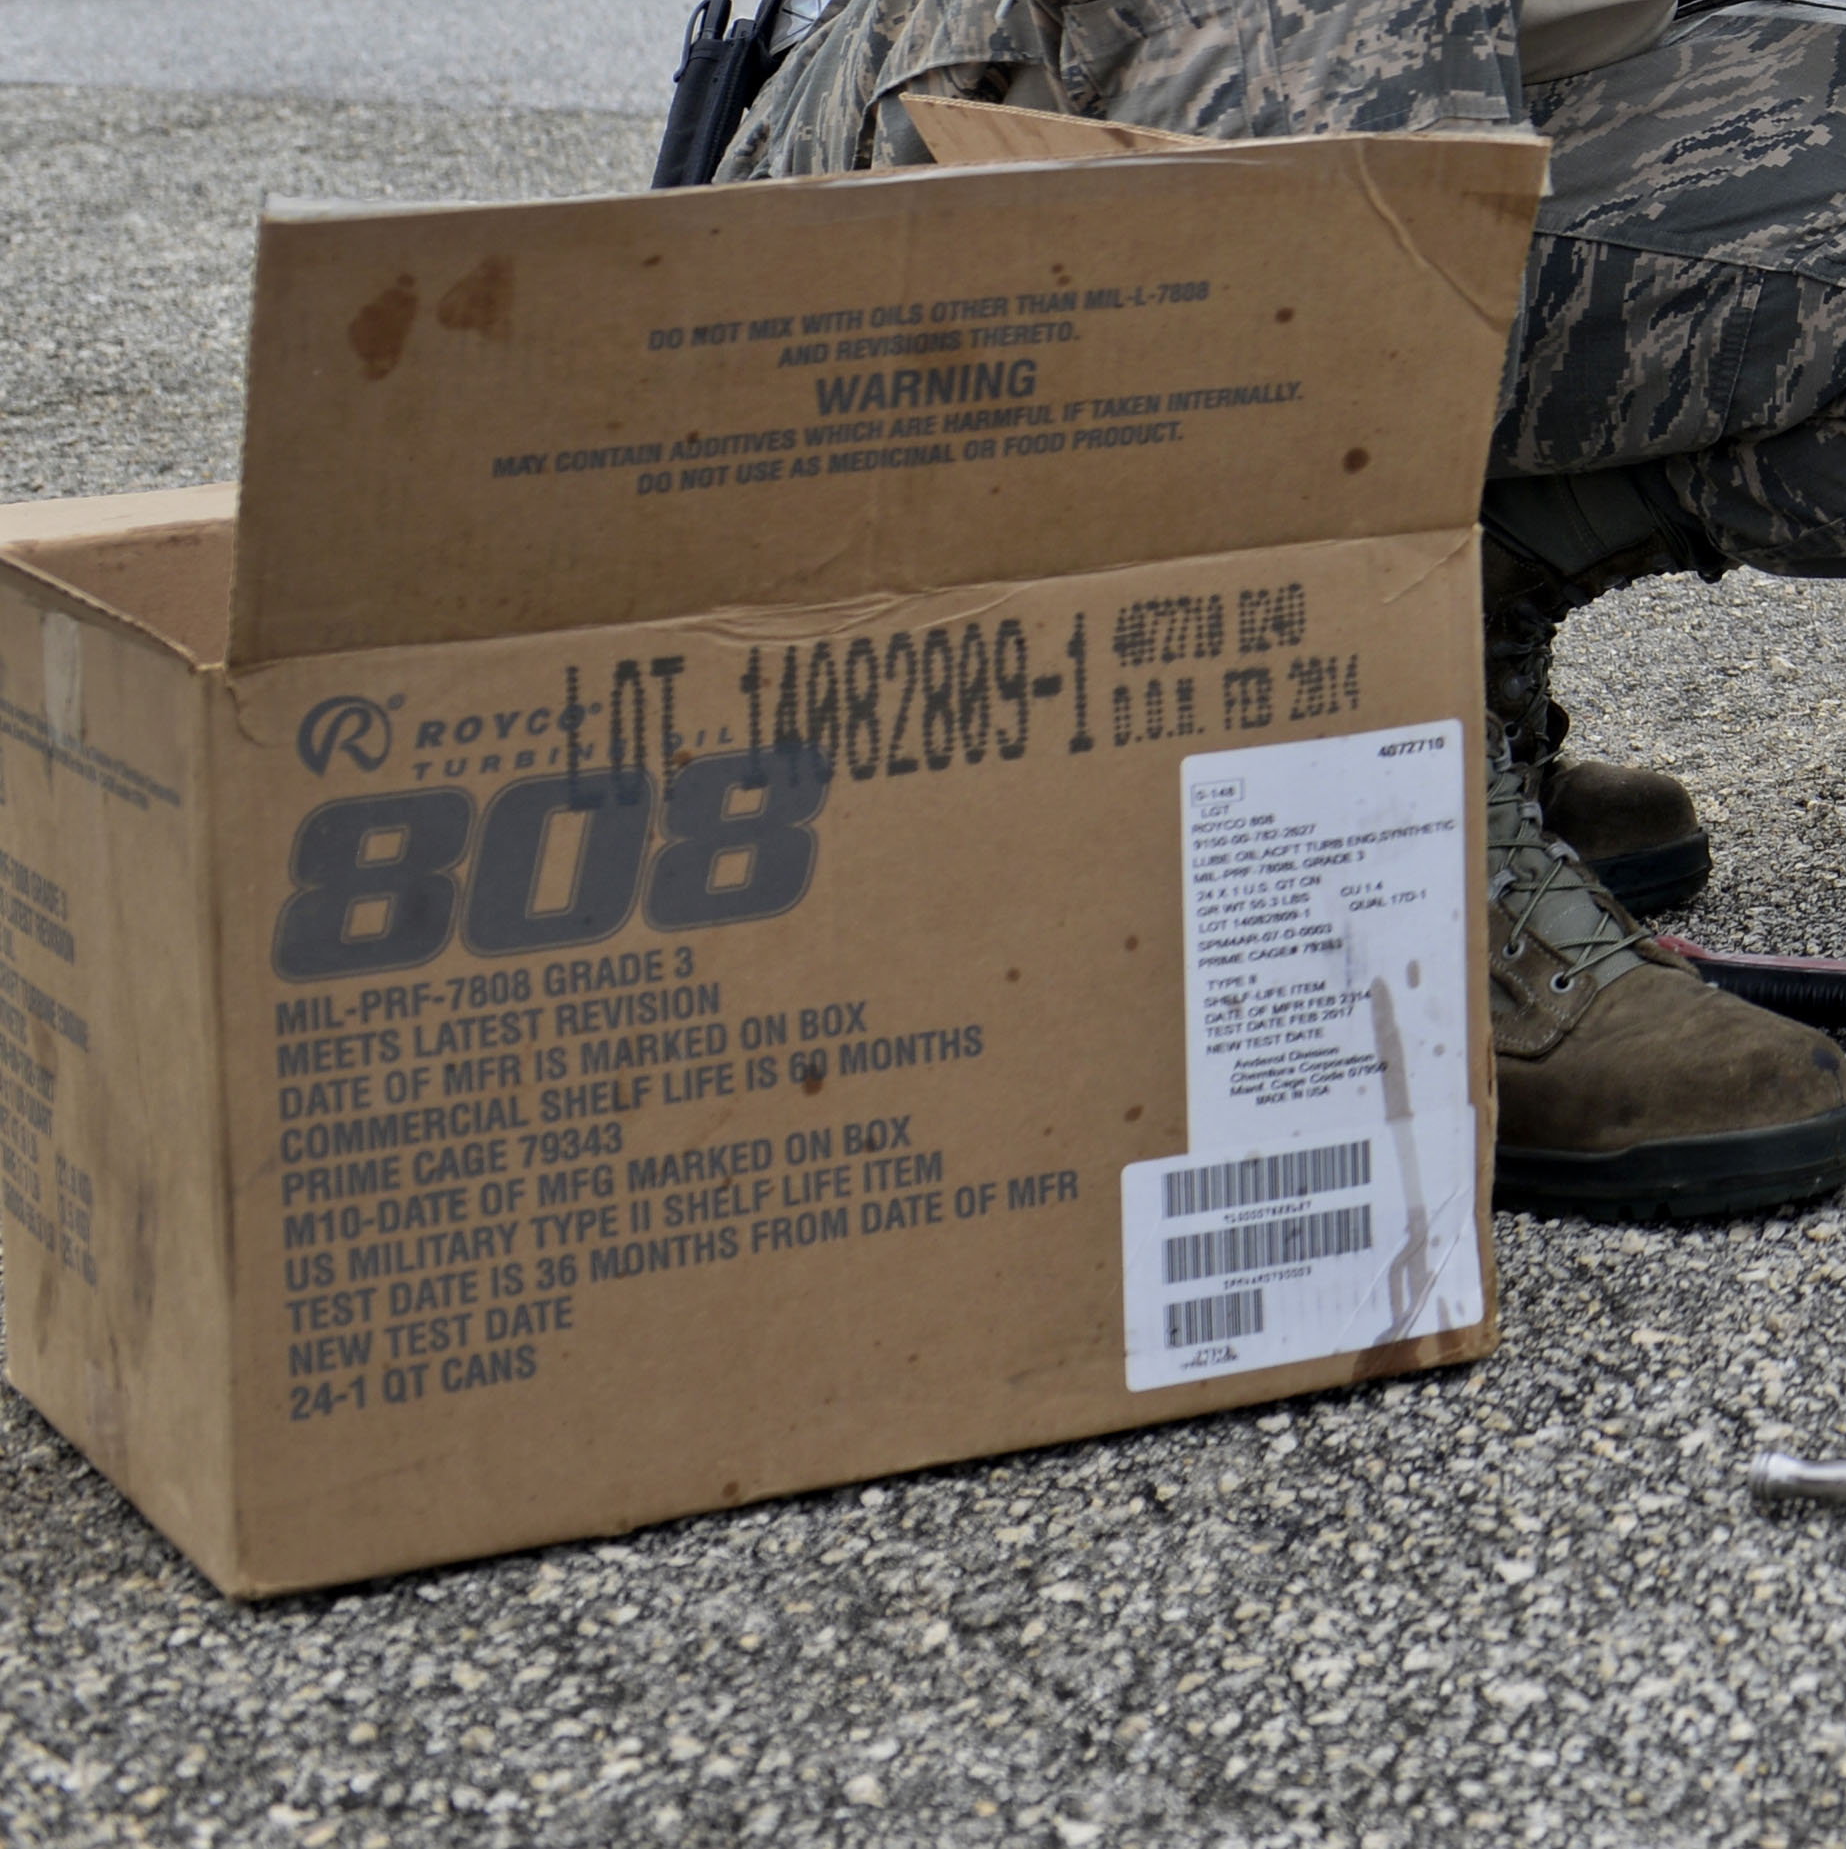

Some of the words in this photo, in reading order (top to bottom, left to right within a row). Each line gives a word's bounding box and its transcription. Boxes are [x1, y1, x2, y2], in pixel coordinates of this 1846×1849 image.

[649, 328, 684, 351] DO
[692, 321, 743, 348] NOT
[748, 316, 795, 342] MIX
[802, 309, 864, 335] WITH
[871, 303, 924, 329] OILS
[931, 296, 1008, 324] OTHER
[1016, 289, 1077, 317] THAN
[777, 342, 829, 368] AND
[835, 329, 961, 362] REVISIONS
[970, 321, 1080, 349] THERETO.
[816, 358, 1038, 417] WARNING
[492, 452, 547, 479] MAY
[554, 442, 662, 473] CONTAIN
[669, 427, 796, 462] ADDITIVES
[804, 419, 883, 448] WHICH
[890, 413, 937, 440] ARE
[943, 403, 1055, 434] HARMFUL
[1063, 400, 1086, 423] IF
[1091, 393, 1160, 419] TAKEN
[1167, 380, 1304, 411] INTERNALLY.
[637, 471, 671, 496] DO
[679, 465, 728, 492] NOT
[736, 460, 783, 484] USE
[789, 455, 821, 479] AS
[828, 440, 955, 473] MEDICINAL
[963, 437, 997, 462] OR
[1003, 431, 1066, 458] FOOD
[1072, 421, 1184, 452] PRODUCT.
[1222, 666, 1275, 732] FEB
[1285, 652, 1360, 722] 2014
[565, 655, 685, 812] LOT
[271, 742, 831, 984] 808
[1191, 818, 1247, 835] ROYCO
[275, 967, 532, 1038] MIL-PRF-7808
[543, 951, 664, 997] GRADE
[674, 945, 695, 979] 3
[1204, 1008, 1243, 1025] DATE
[1247, 1005, 1269, 1018] OF
[1308, 994, 1337, 1009] FEB
[1207, 975, 1244, 991] TYPE
[1290, 979, 1327, 994] ITEM
[277, 1028, 401, 1079] MEETS
[413, 1006, 545, 1058] LATEST
[555, 981, 721, 1038] REVISION
[279, 1075, 371, 1122] DATE
[384, 1066, 431, 1105] OF
[444, 1053, 522, 1097] MFR
[535, 1046, 567, 1083] IS
[581, 1022, 729, 1077] MARKED
[740, 1013, 787, 1050] ON
[801, 999, 868, 1042] BOX
[1205, 1022, 1243, 1038] TEST
[1247, 1016, 1285, 1032] DATE
[1289, 1011, 1318, 1025] FEB
[1205, 1040, 1242, 1056] NEW
[1246, 1034, 1281, 1048] TEST
[1285, 1026, 1325, 1042] DATE
[280, 1095, 530, 1165] COMMERCIAL
[540, 1075, 653, 1124] SHELF
[662, 1062, 735, 1106] LIFE
[746, 1056, 779, 1092] IS
[788, 1049, 828, 1086] 60
[838, 1024, 984, 1077] MONTHS
[1255, 1090, 1289, 1106] MADE
[1305, 1084, 1331, 1098] USA
[281, 1155, 401, 1208] PRIME
[412, 1138, 508, 1187] CAGE
[518, 1121, 624, 1169] 79343
[283, 1186, 468, 1250] M10-DATE
[480, 1176, 526, 1217] OF
[537, 1163, 615, 1208] MFG
[627, 1137, 772, 1193] MARKED
[785, 1127, 831, 1167] ON
[843, 1114, 912, 1158] BOX
[285, 1252, 335, 1293] US
[349, 1220, 520, 1282] MILITARY
[529, 1204, 619, 1250] TYPE
[630, 1200, 652, 1233] II
[664, 1179, 773, 1228] SHELF
[782, 1164, 852, 1207] LIFE
[862, 1150, 944, 1193] ITEM
[285, 1287, 378, 1334] TEST
[388, 1269, 479, 1318] DATE
[491, 1262, 525, 1299] IS
[535, 1253, 577, 1291] 36
[589, 1226, 739, 1283] MONTHS
[750, 1206, 849, 1255] FROM
[860, 1191, 944, 1236] DATE
[954, 1181, 997, 1221] OF
[1007, 1169, 1080, 1212] MFR
[288, 1329, 373, 1378] NEW
[383, 1312, 473, 1360] TEST
[485, 1295, 574, 1343] DATE
[290, 1374, 367, 1422] 24-1
[382, 1362, 430, 1404] QT
[441, 1343, 538, 1394] CANS
